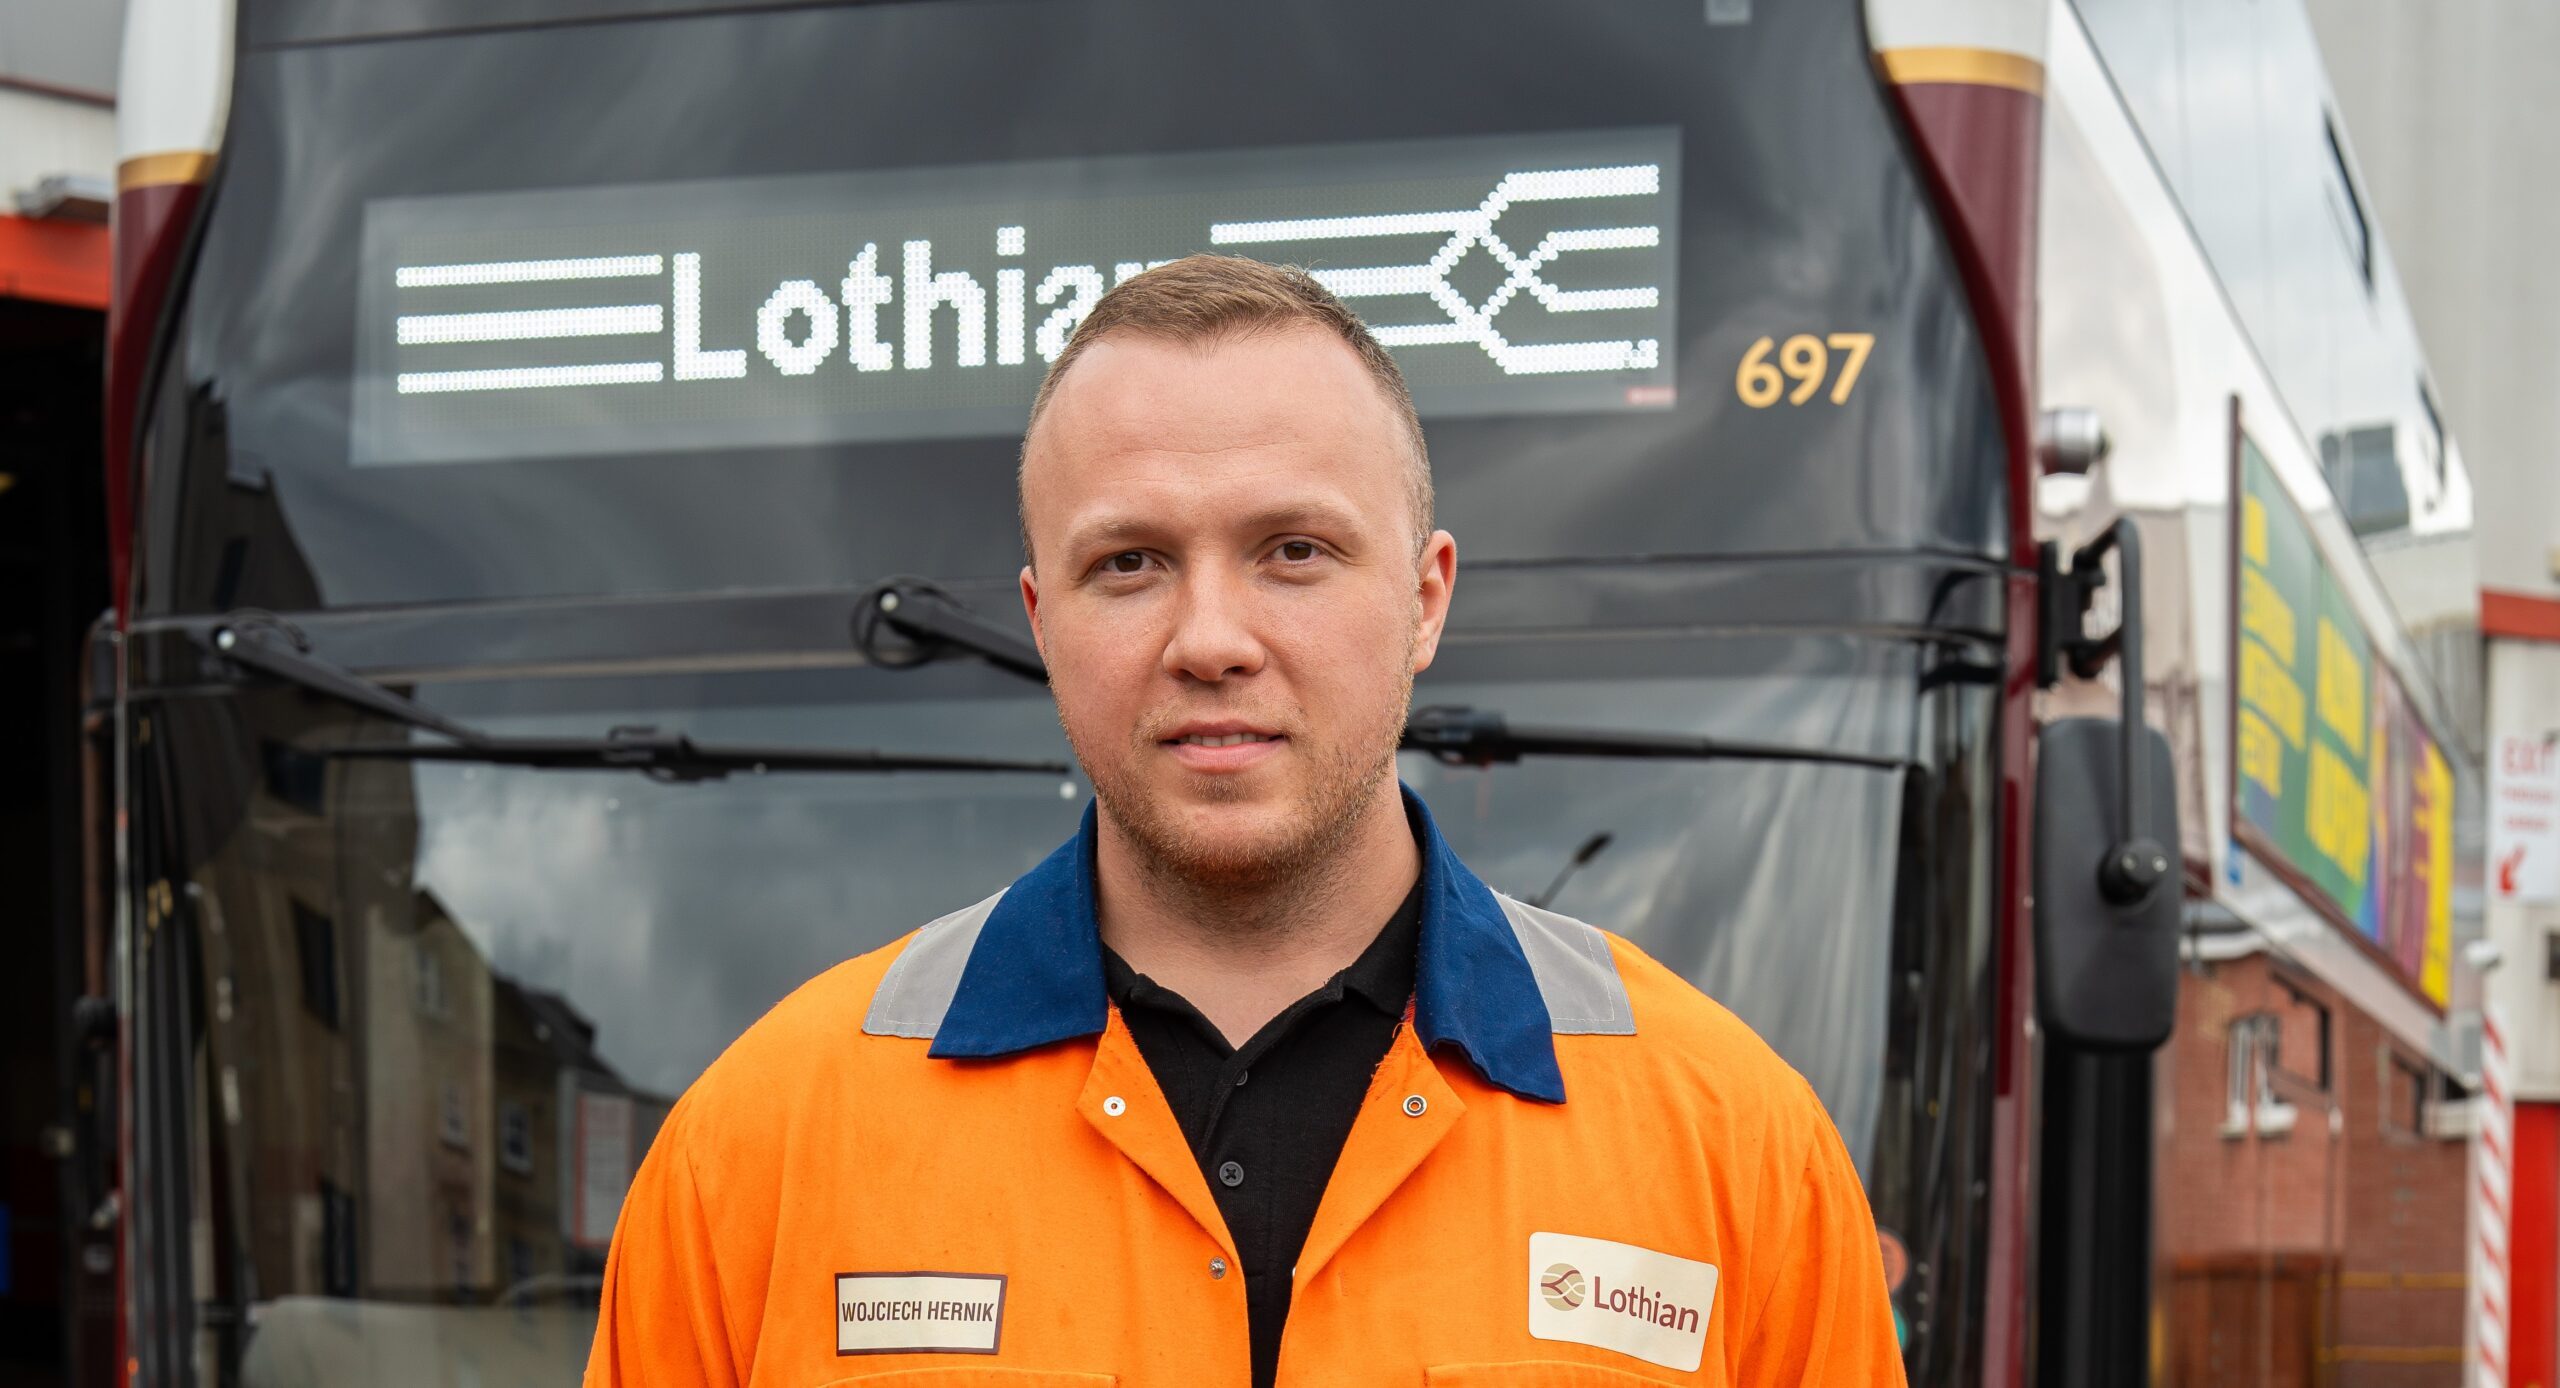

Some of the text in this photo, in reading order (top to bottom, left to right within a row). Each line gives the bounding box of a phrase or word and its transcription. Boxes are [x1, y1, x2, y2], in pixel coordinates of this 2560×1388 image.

[673, 225, 1177, 381] Lothia
[1736, 332, 1875, 408] 697
[842, 1301, 994, 1322] WOJCIECH HERNIK
[1594, 1276, 1699, 1333] Lothian
